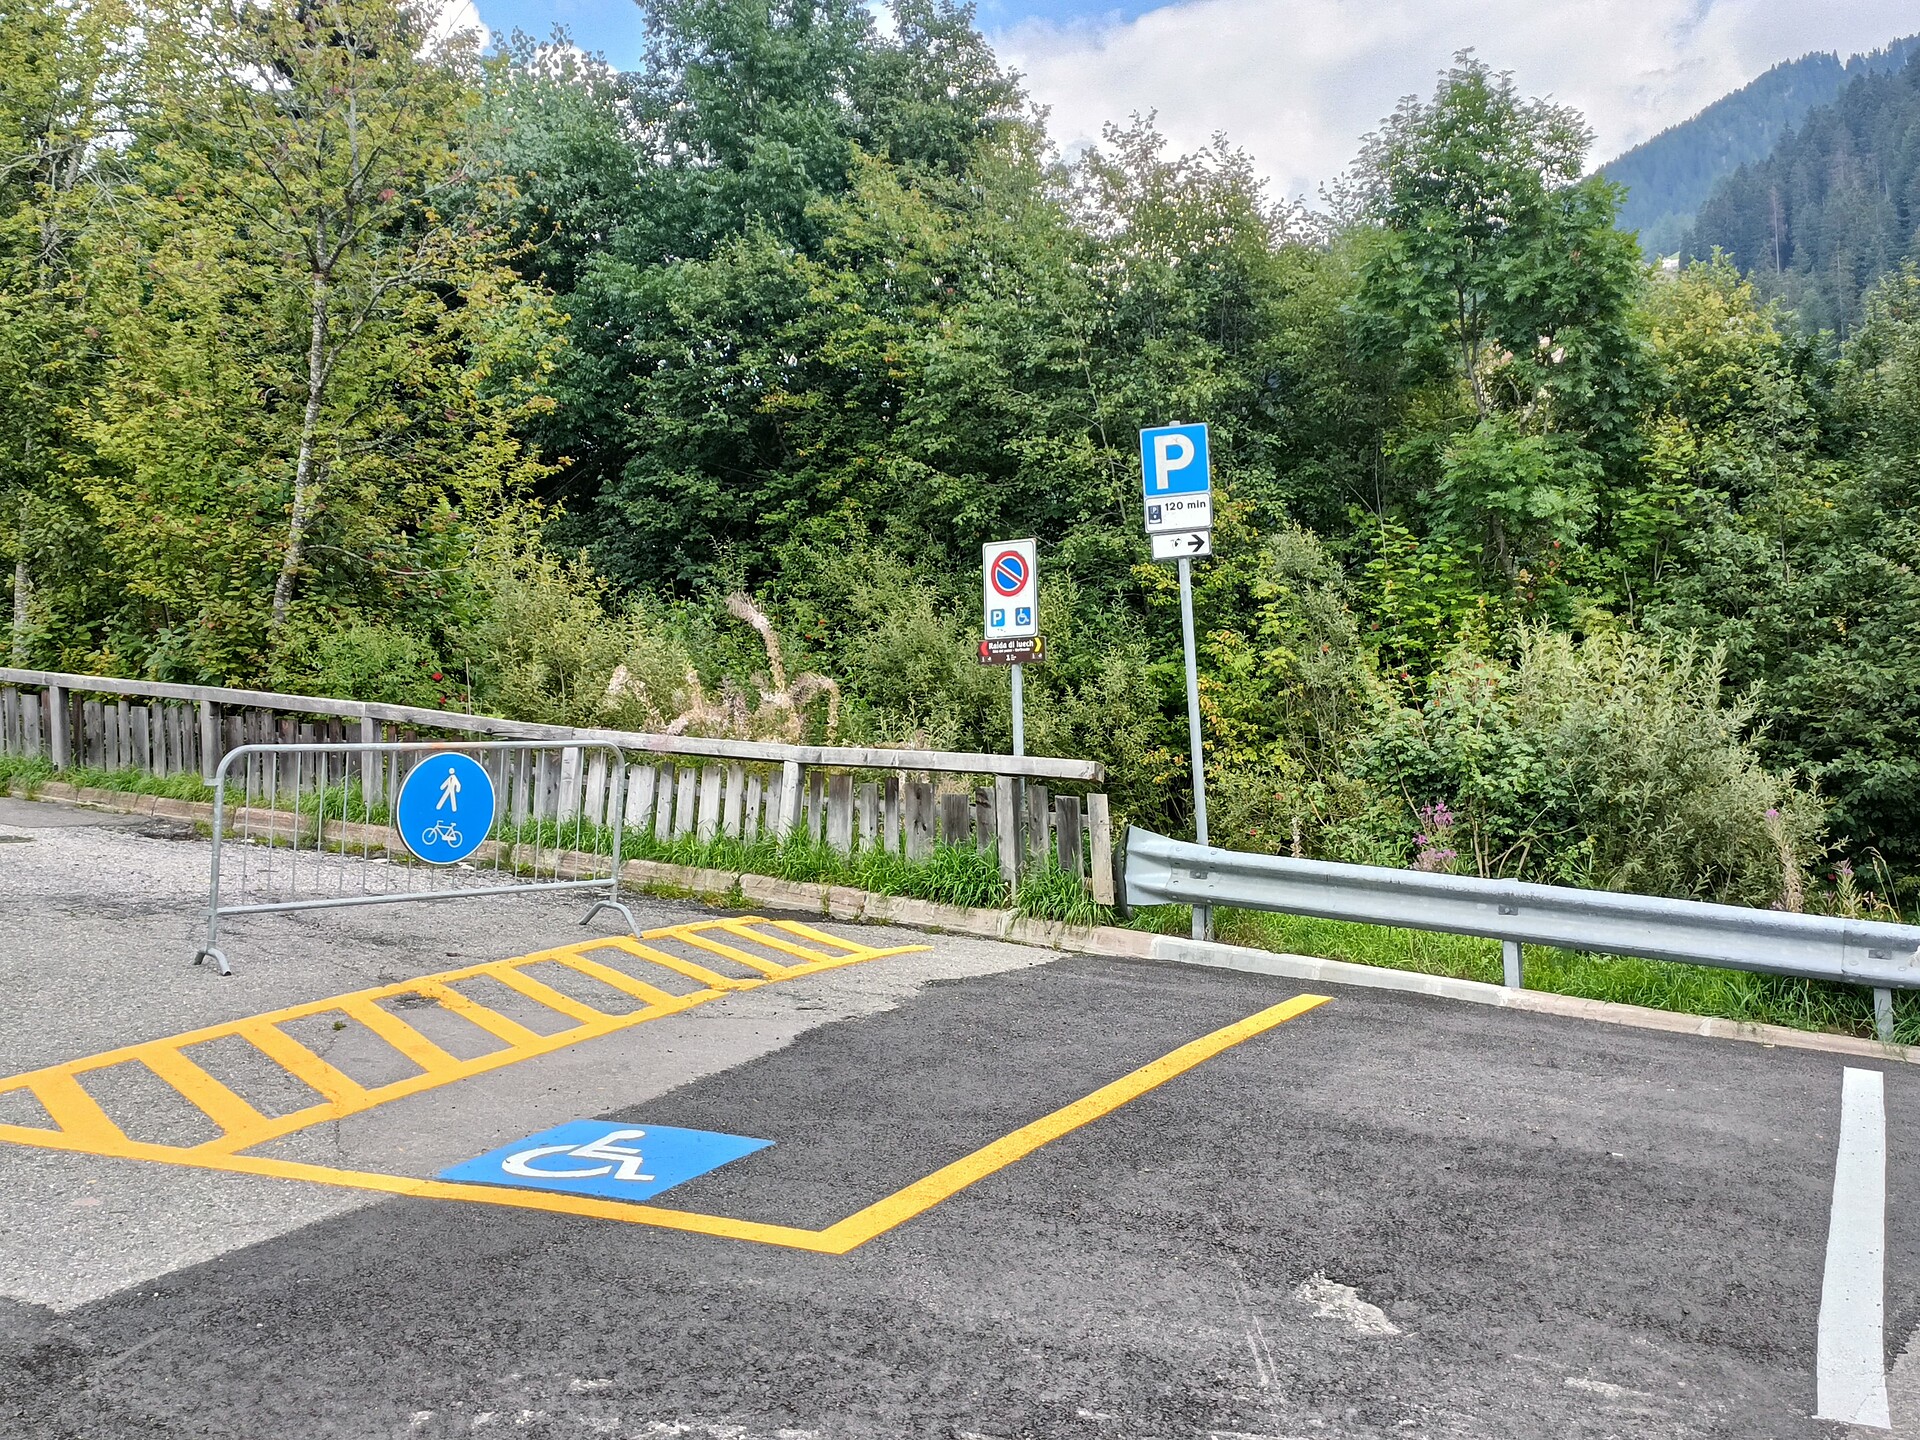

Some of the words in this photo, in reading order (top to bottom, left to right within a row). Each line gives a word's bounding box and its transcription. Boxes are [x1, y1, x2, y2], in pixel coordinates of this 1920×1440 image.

[1154, 434, 1195, 490] P
[1165, 501, 1183, 511] 120
[1187, 500, 1206, 510] min
[993, 611, 1002, 625] P
